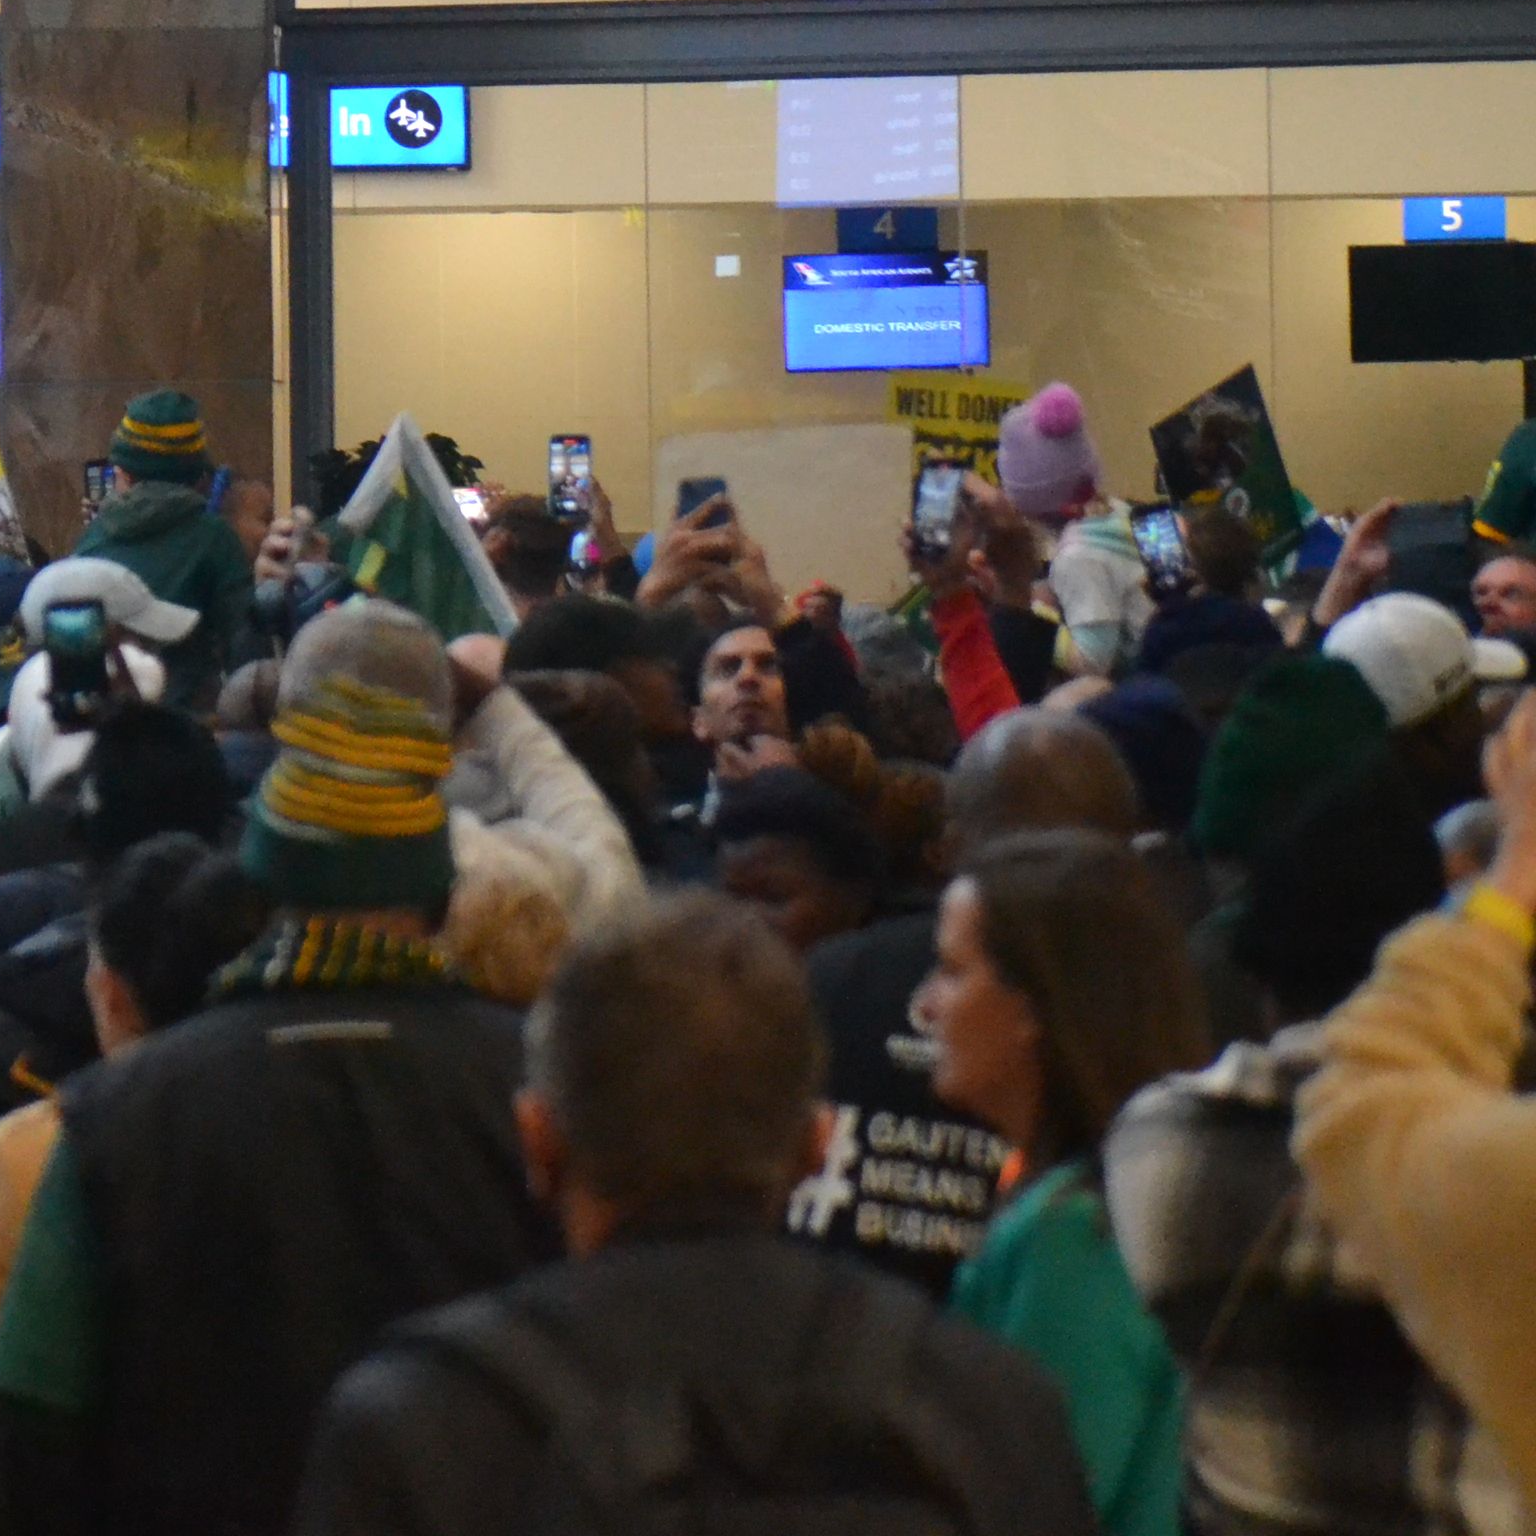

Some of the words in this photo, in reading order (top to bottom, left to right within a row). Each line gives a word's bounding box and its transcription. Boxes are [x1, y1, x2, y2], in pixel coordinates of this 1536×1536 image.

[339, 105, 372, 137] In
[873, 210, 897, 240] 4
[1440, 199, 1464, 232] 5
[813, 322, 885, 335] DOMESTIC
[888, 320, 962, 332] TRANSFER
[896, 386, 950, 419] WELL
[866, 1111, 1013, 1171] GAUTEN
